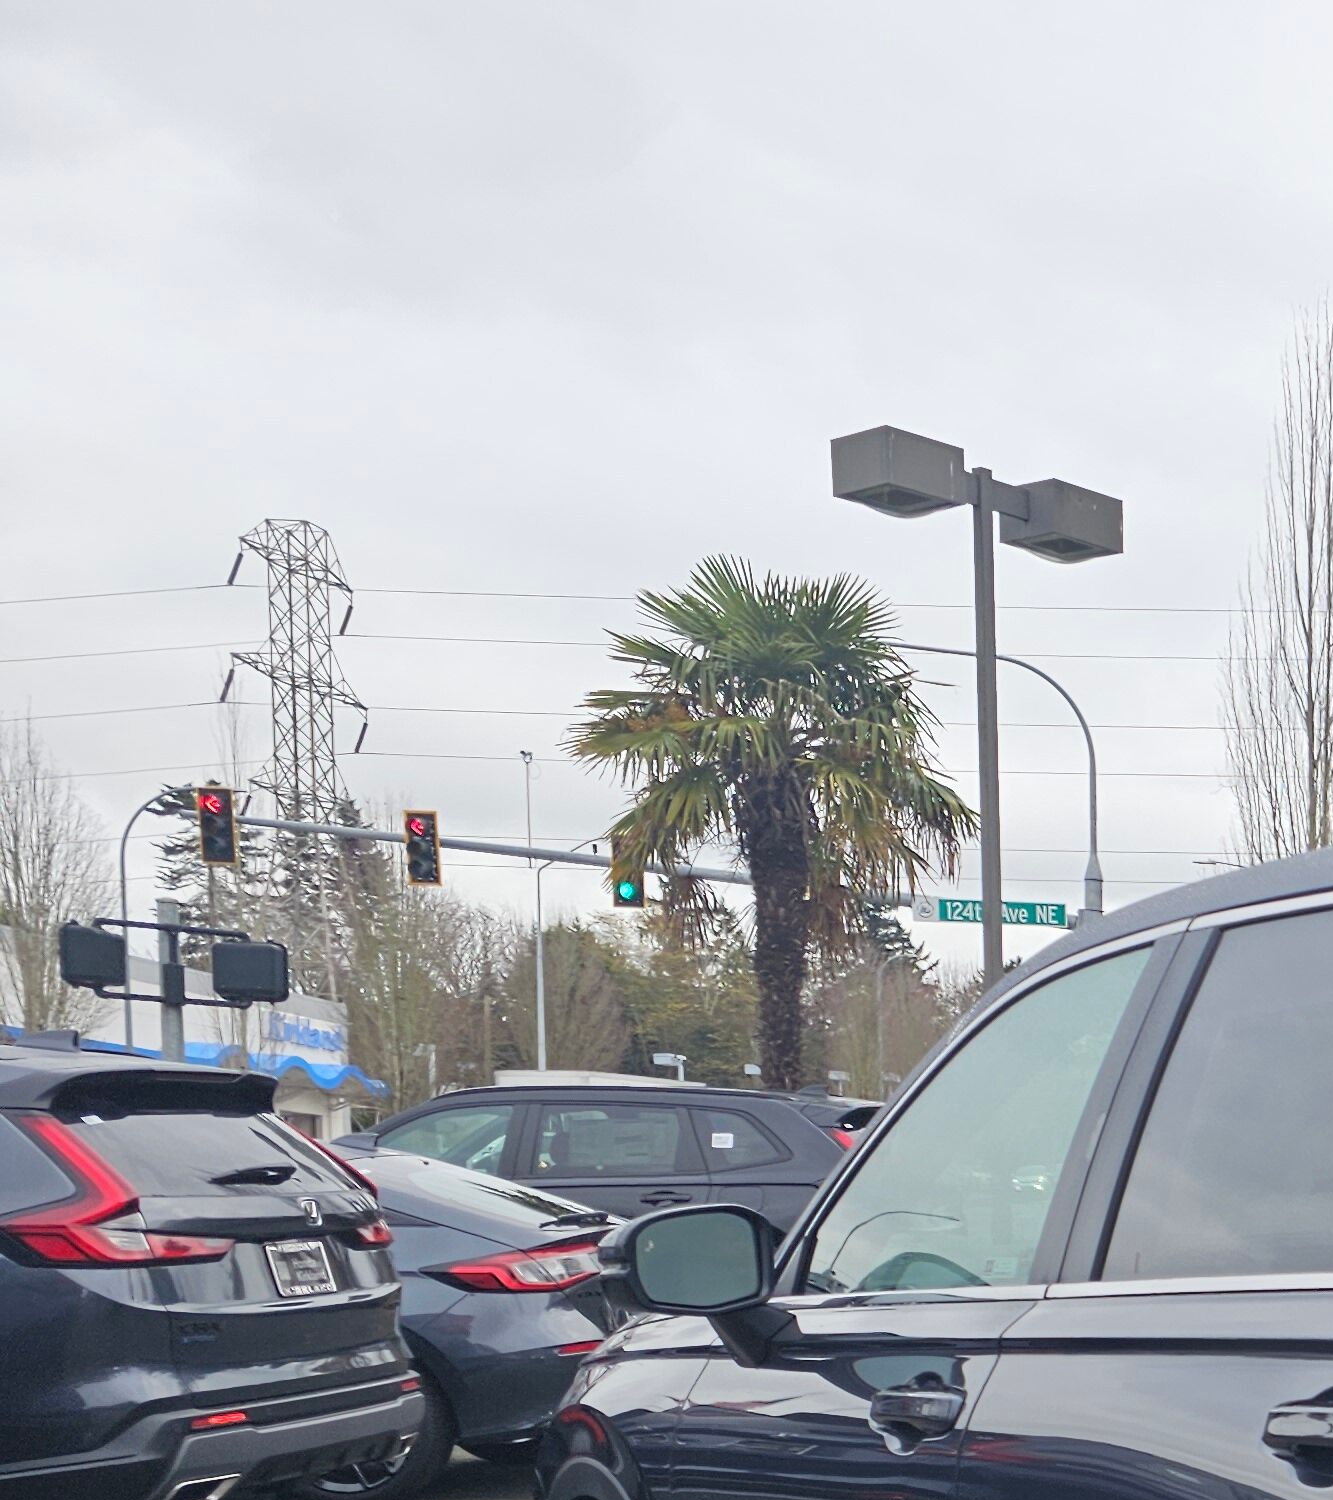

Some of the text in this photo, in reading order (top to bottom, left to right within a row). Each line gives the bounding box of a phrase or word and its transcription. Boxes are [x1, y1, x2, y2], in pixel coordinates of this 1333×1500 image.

[945, 901, 1059, 925] 124t Ave NE
